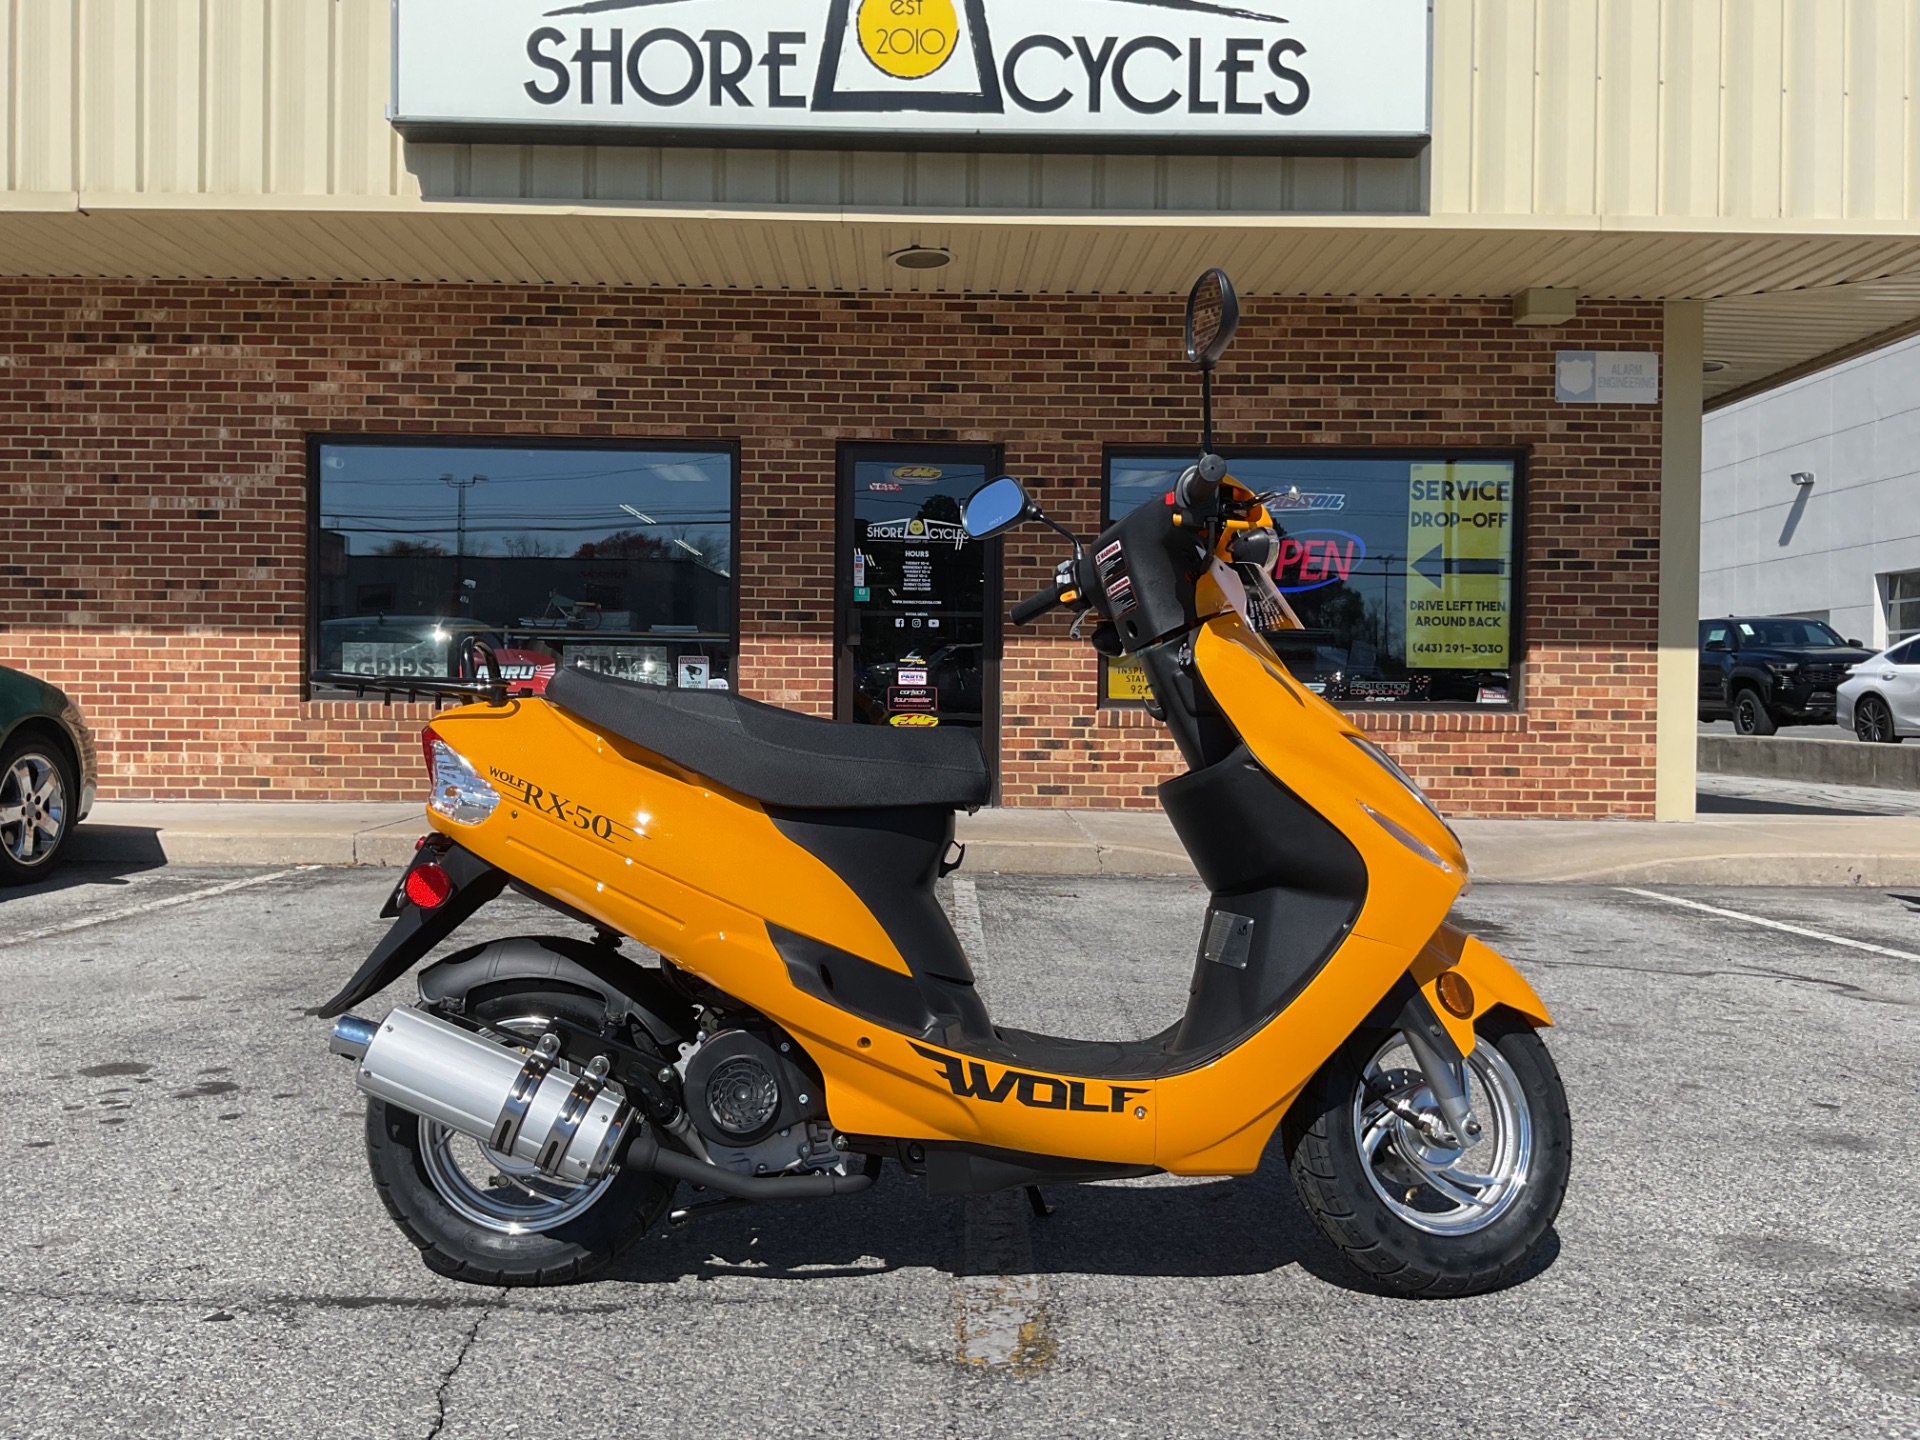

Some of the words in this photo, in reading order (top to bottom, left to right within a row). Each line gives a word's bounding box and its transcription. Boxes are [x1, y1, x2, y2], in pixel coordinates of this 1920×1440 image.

[876, 28, 946, 54] 2010
[523, 27, 807, 107] SHORE
[1002, 34, 1310, 116] CYCLES
[1611, 364, 1643, 376] ALARM
[1598, 377, 1655, 388] ENGINEERING
[1411, 480, 1510, 501] SERVICE
[1265, 493, 1345, 511] AMSOIL
[1411, 512, 1508, 528] DROP-OFF
[867, 527, 904, 538] SHORE
[1276, 539, 1354, 580] PEN
[1410, 601, 1444, 611] DRIVE
[1446, 601, 1473, 611] LEFT
[1475, 601, 1506, 611] THEN
[1415, 616, 1466, 627] AROUND
[1468, 617, 1502, 627] BACK
[1412, 643, 1442, 653] (443)
[1445, 643, 1504, 653] 291-3030
[355, 657, 435, 677] GRIPS
[1118, 666, 1144, 674] INSPE
[1350, 681, 1410, 689] PROTECTION
[489, 766, 525, 788] WOLF
[521, 781, 615, 843] RX-50
[905, 1039, 1152, 1113] WOLF
